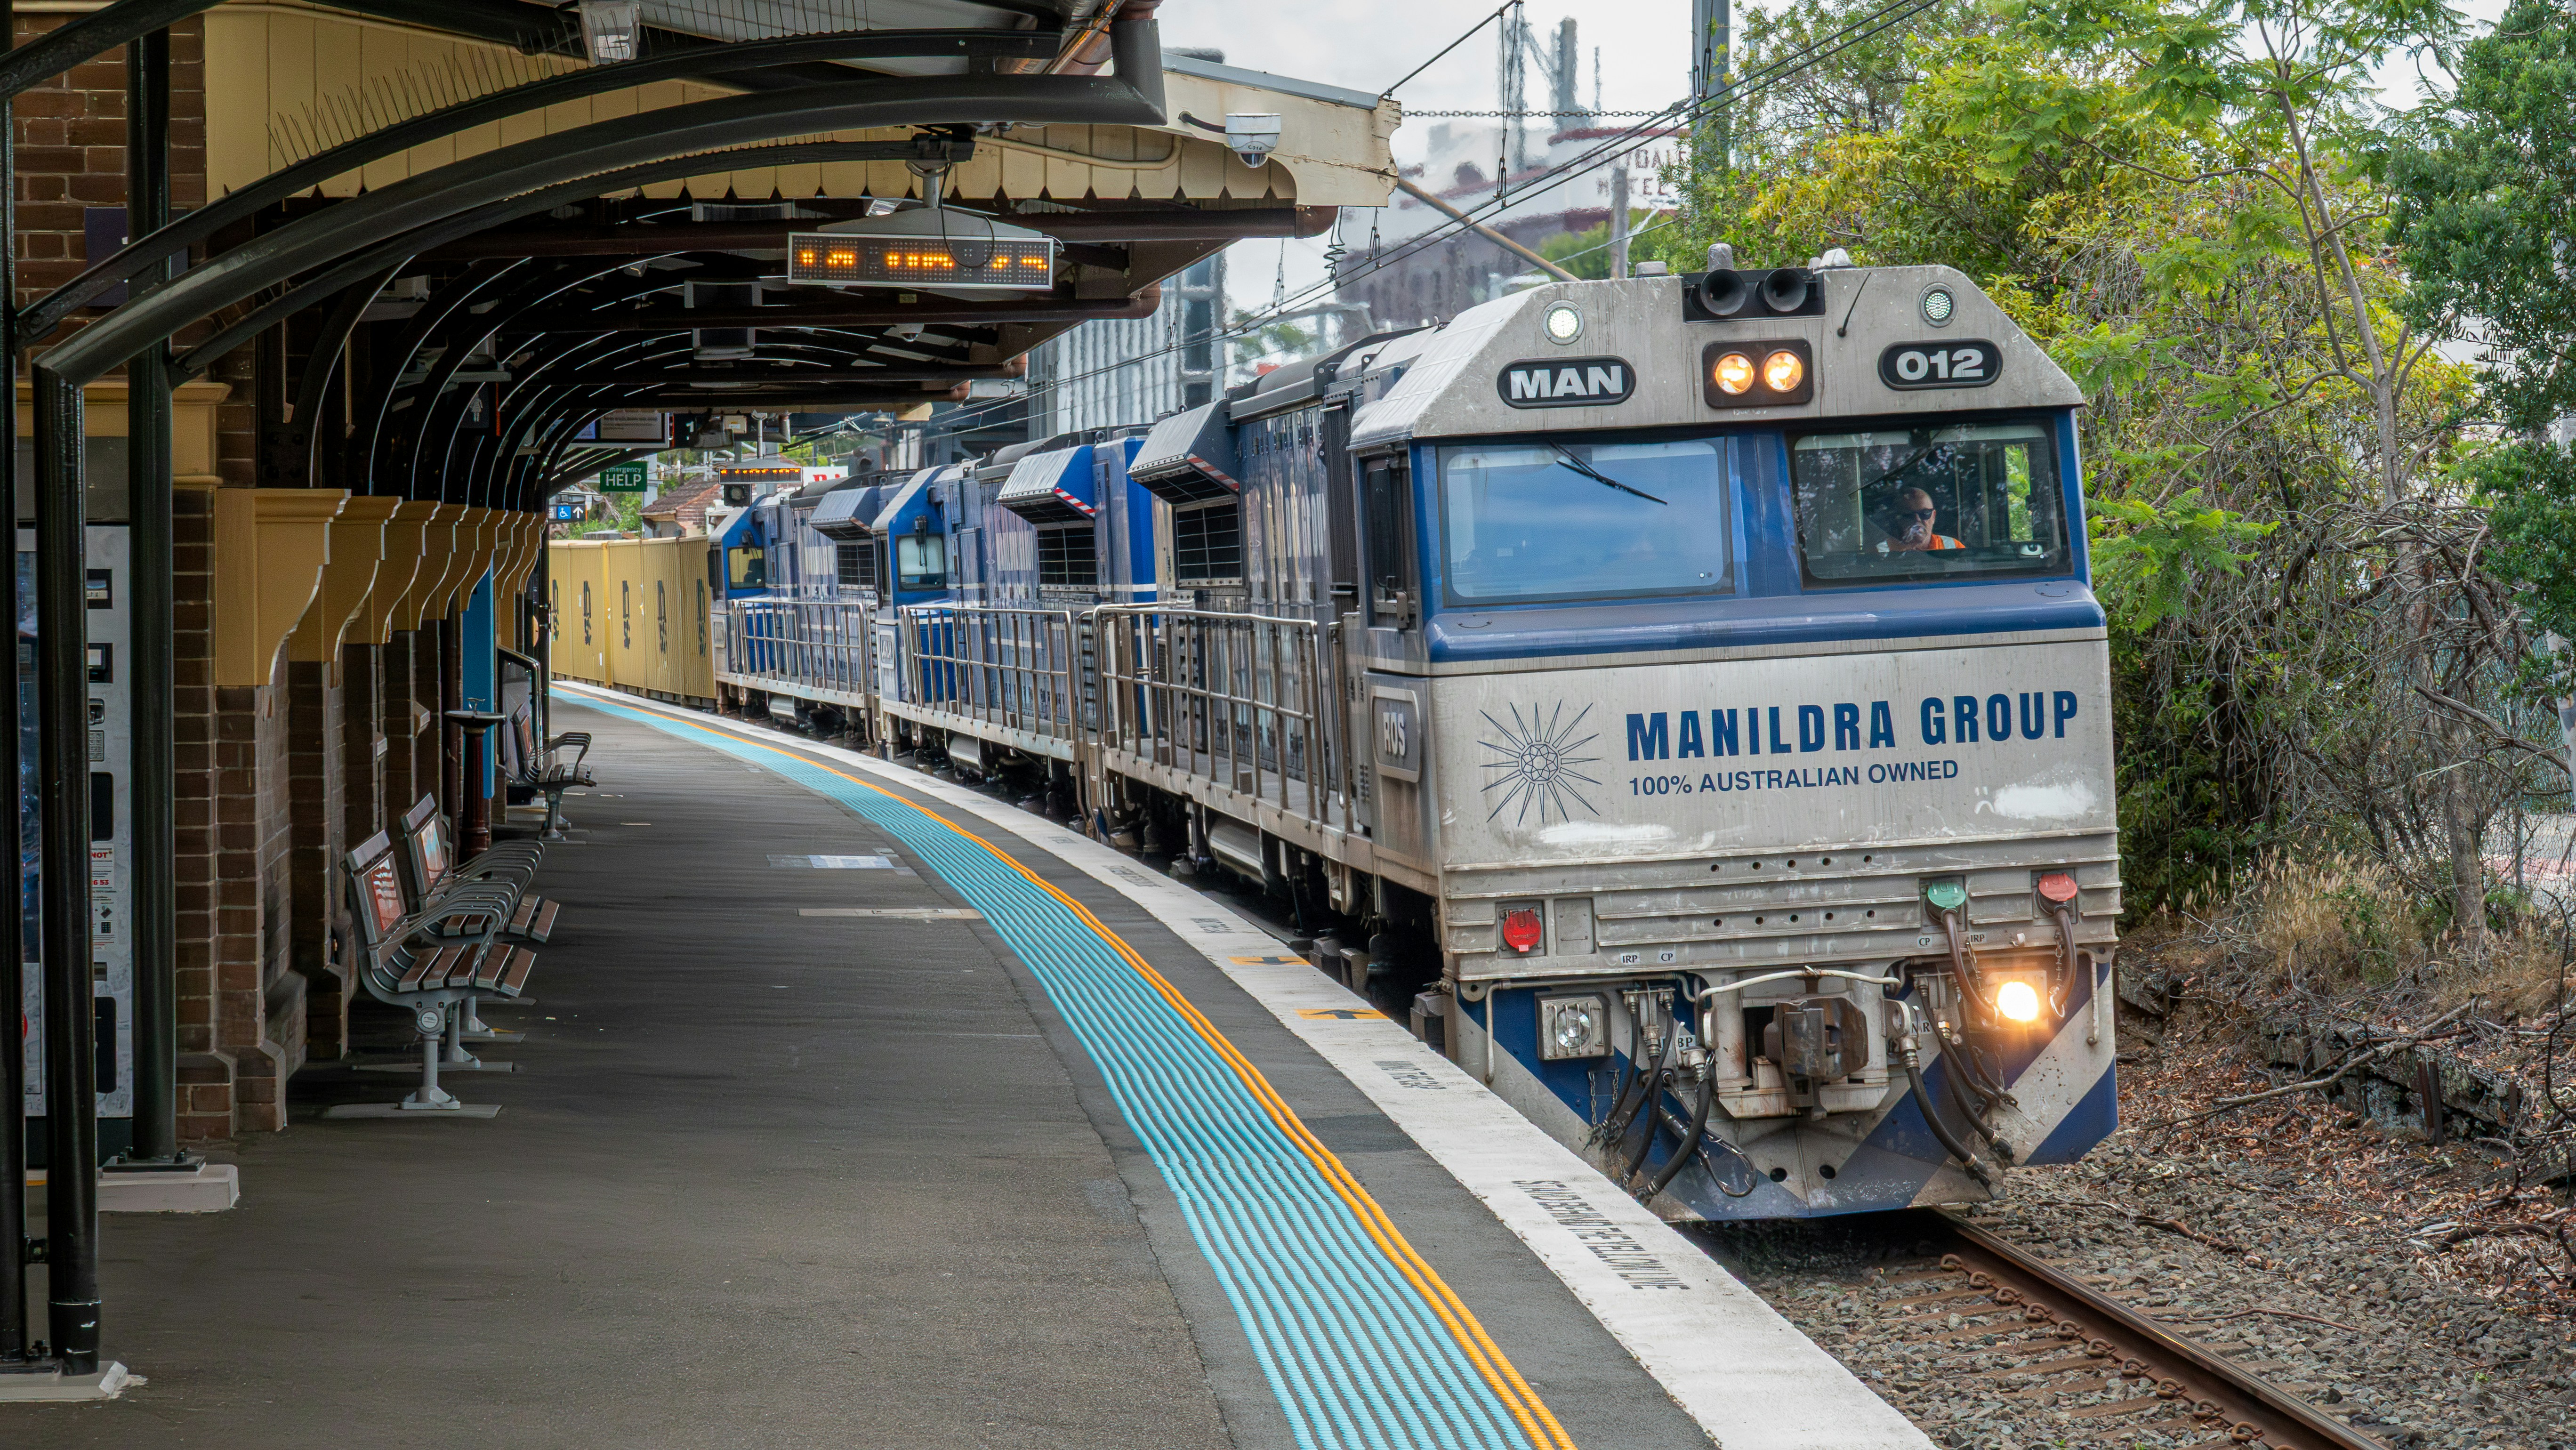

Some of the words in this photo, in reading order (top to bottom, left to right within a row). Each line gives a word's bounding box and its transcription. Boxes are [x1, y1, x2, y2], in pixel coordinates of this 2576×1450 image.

[1595, 176, 1669, 197] HTEL
[1896, 348, 1984, 380] 012
[1510, 365, 1623, 399] MAN
[606, 474, 642, 486] HELP
[1383, 712, 1406, 756] ROS
[1626, 700, 1896, 761] MANILDRA
[1921, 690, 2078, 746] GROUP
[1628, 773, 1692, 796] 100%
[1699, 765, 1860, 793] AUSTRALIAN
[1868, 759, 1958, 784] OWNED
[1919, 938, 1930, 946] CP
[1970, 934, 1985, 943] IRP
[1622, 955, 1638, 963] IRP
[1661, 953, 1673, 961] CP
[1678, 1037, 1693, 1047] BP
[1511, 1180, 1582, 1200] STAND
[1537, 1201, 1614, 1226] BEHIND
[1567, 1227, 1633, 1240] THE
[1582, 1241, 1669, 1271] YELLOW
[1616, 1273, 1691, 1290] LINE
